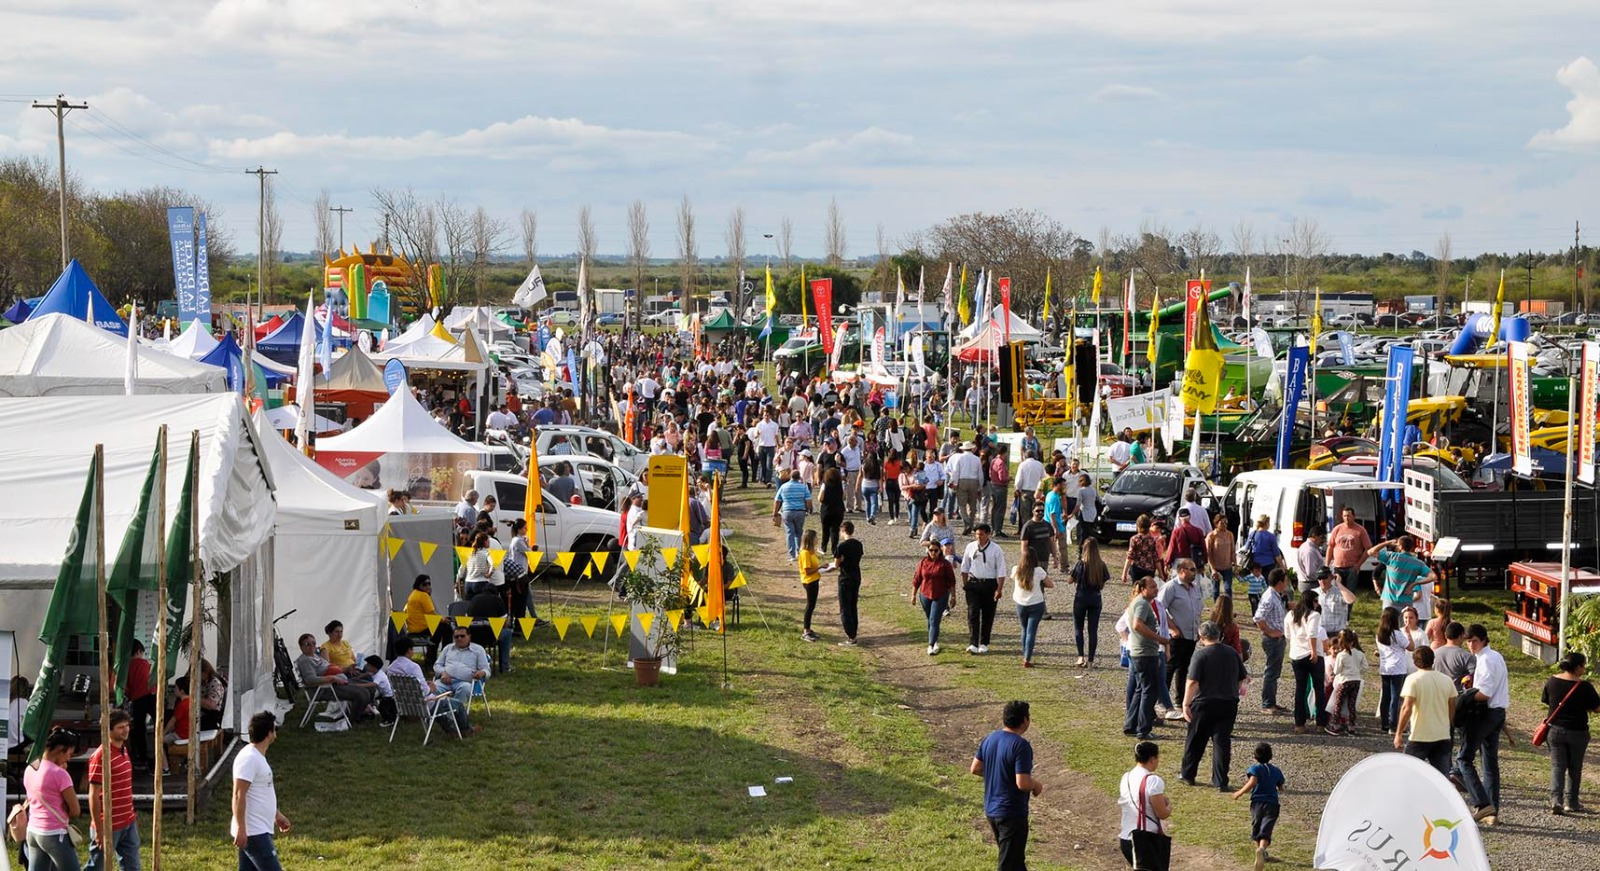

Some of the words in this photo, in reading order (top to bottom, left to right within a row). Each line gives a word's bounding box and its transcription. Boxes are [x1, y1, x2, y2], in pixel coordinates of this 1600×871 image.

[95, 320, 122, 330] BASF
[1182, 384, 1211, 400] UNY
[1123, 470, 1179, 479] BANCHIK
